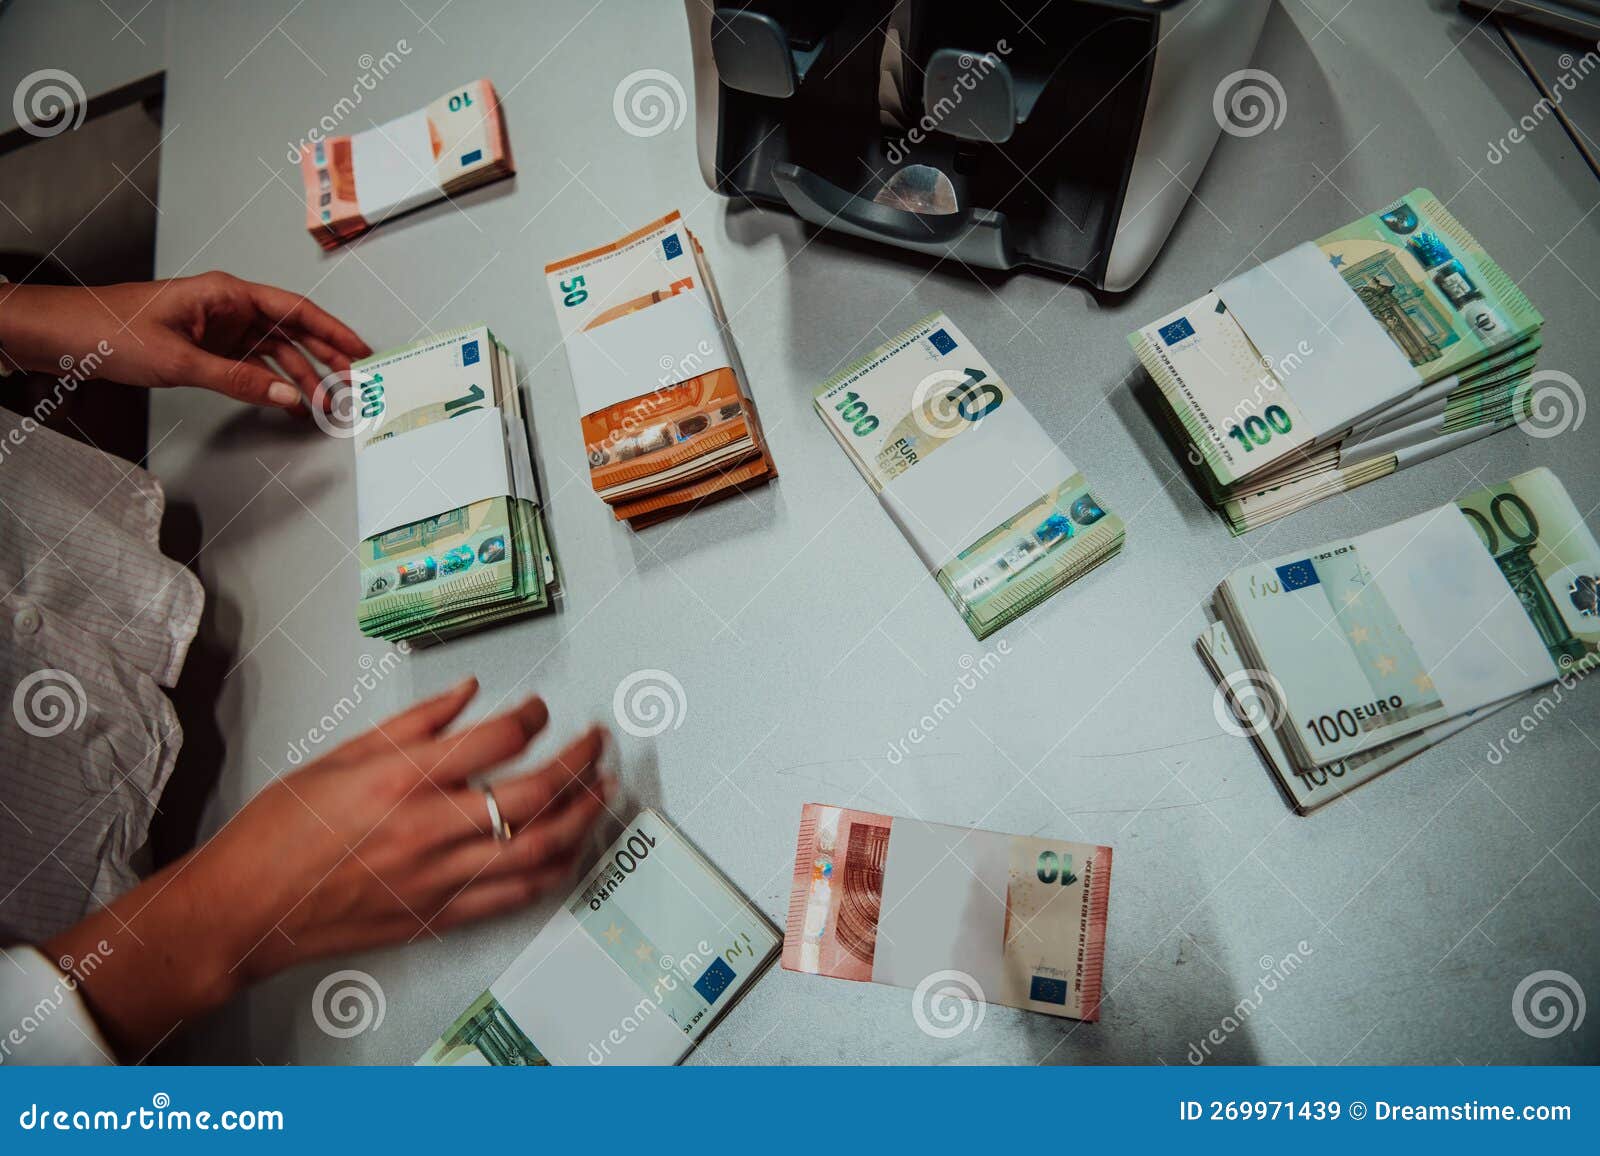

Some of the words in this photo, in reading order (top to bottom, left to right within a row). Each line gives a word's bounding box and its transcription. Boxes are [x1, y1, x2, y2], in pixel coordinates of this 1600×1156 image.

[448, 91, 473, 112] 10
[560, 275, 588, 308] 50
[360, 373, 385, 418] 100
[835, 391, 880, 437] 100
[1229, 405, 1292, 452] 100
[1319, 551, 1331, 560] BCE
[1307, 709, 1359, 746] 100
[1355, 695, 1403, 720] EURO
[615, 828, 656, 873] 100
[1036, 851, 1078, 886] 10
[589, 869, 626, 912] EURO
